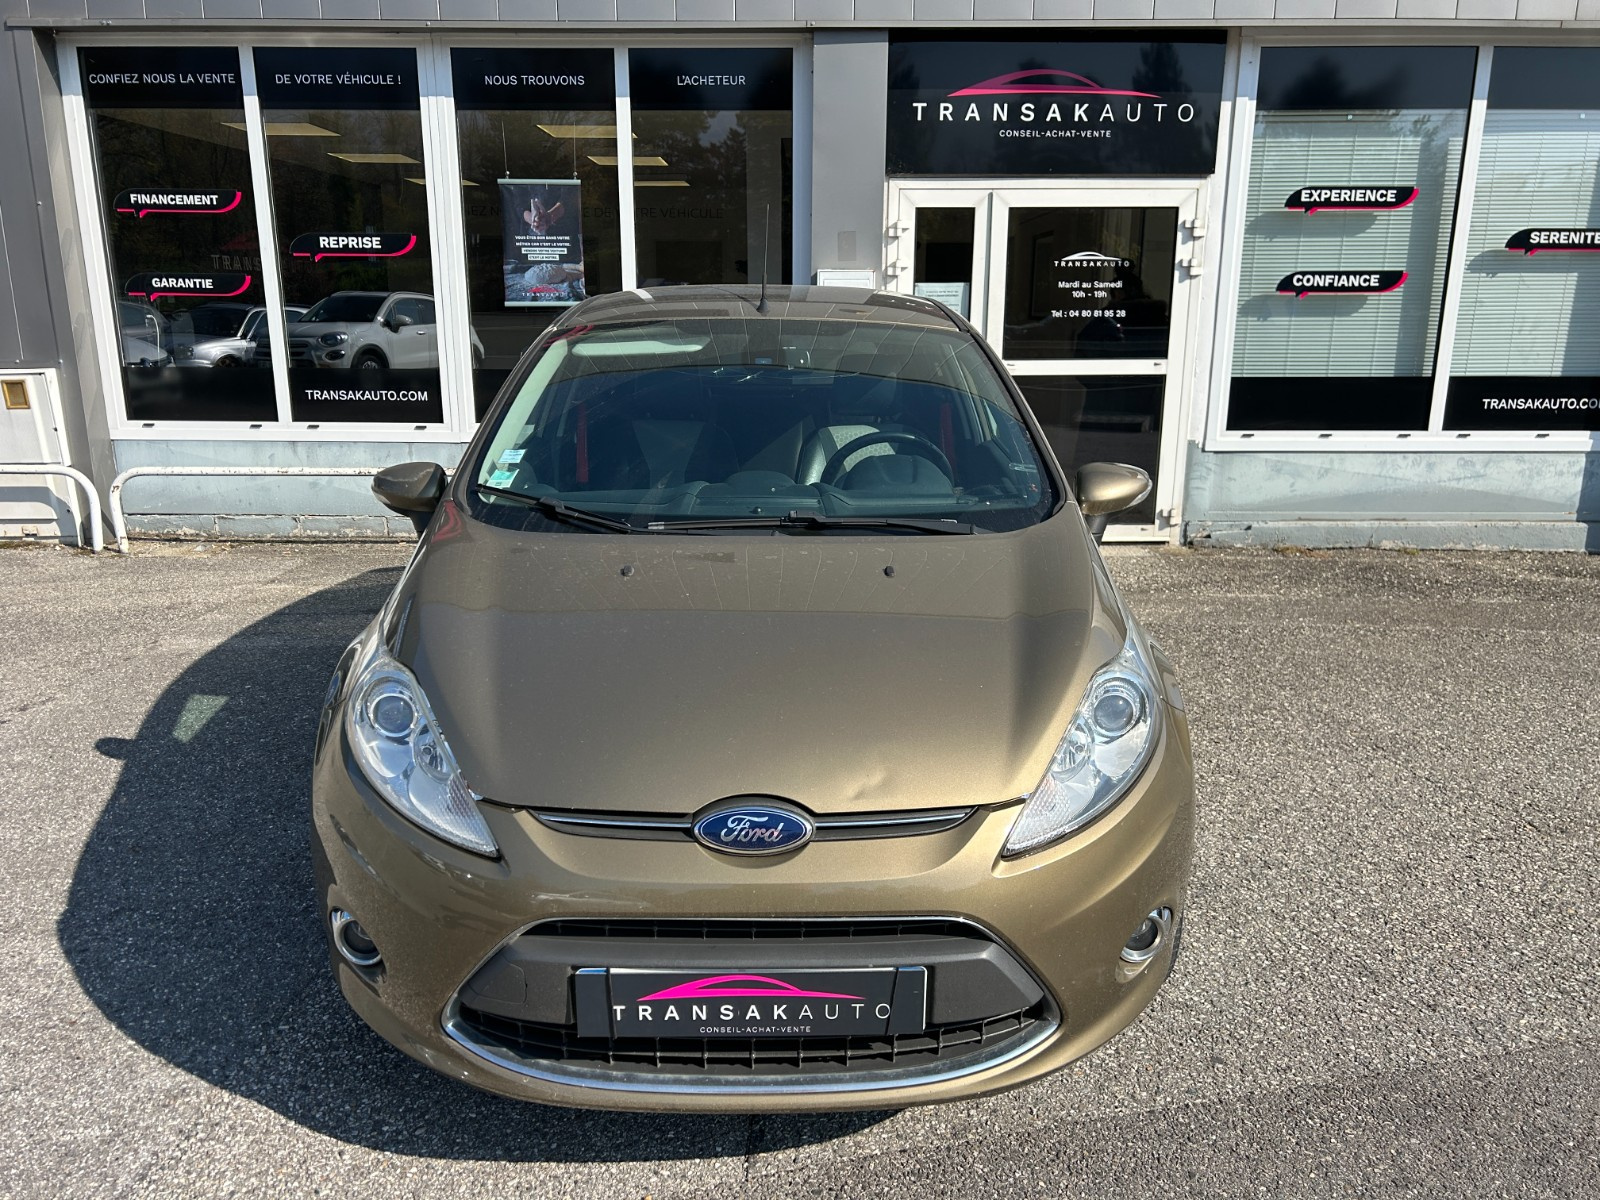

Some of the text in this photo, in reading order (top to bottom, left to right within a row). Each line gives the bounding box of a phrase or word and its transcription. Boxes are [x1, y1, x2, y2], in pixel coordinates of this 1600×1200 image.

[89, 73, 236, 84] CONFIEZ NOUS LA VENTE
[275, 74, 292, 85] DE
[294, 74, 333, 85] VOTRE
[336, 71, 394, 85] VÉHICULE
[484, 75, 585, 86] NOUS TROUVONS
[677, 75, 746, 86] L'ACHETEUR
[912, 102, 1195, 123] TRANSAKAUTO
[999, 129, 1112, 138] CONSEIL-ACHAT-VENTE
[129, 193, 218, 206] FINANCEMENT
[1300, 188, 1397, 203] EXPERIENCE
[318, 236, 382, 250] REPRISE
[1529, 231, 1600, 245] SERENITE
[151, 277, 214, 289] GARANTIE
[1058, 280, 1080, 289] Mardi
[1093, 280, 1123, 289] Samedi
[1292, 274, 1380, 288] CONFIANCE
[1072, 290, 1086, 299] 10h
[1094, 290, 1108, 299] 19h
[1068, 309, 1080, 318] 04
[1081, 309, 1092, 318] 80
[1093, 309, 1103, 318] 81
[1103, 309, 1115, 318] 95
[1115, 309, 1127, 318] 28
[305, 389, 429, 402] TRANSAKAUTO.COM
[1482, 398, 1600, 410] TRANSAKAUTO.CO
[720, 814, 784, 843] Ford
[612, 1003, 892, 1021] TRANSAKAUTO
[699, 1026, 812, 1034] CONSEIL-ACHAT-VENTE
